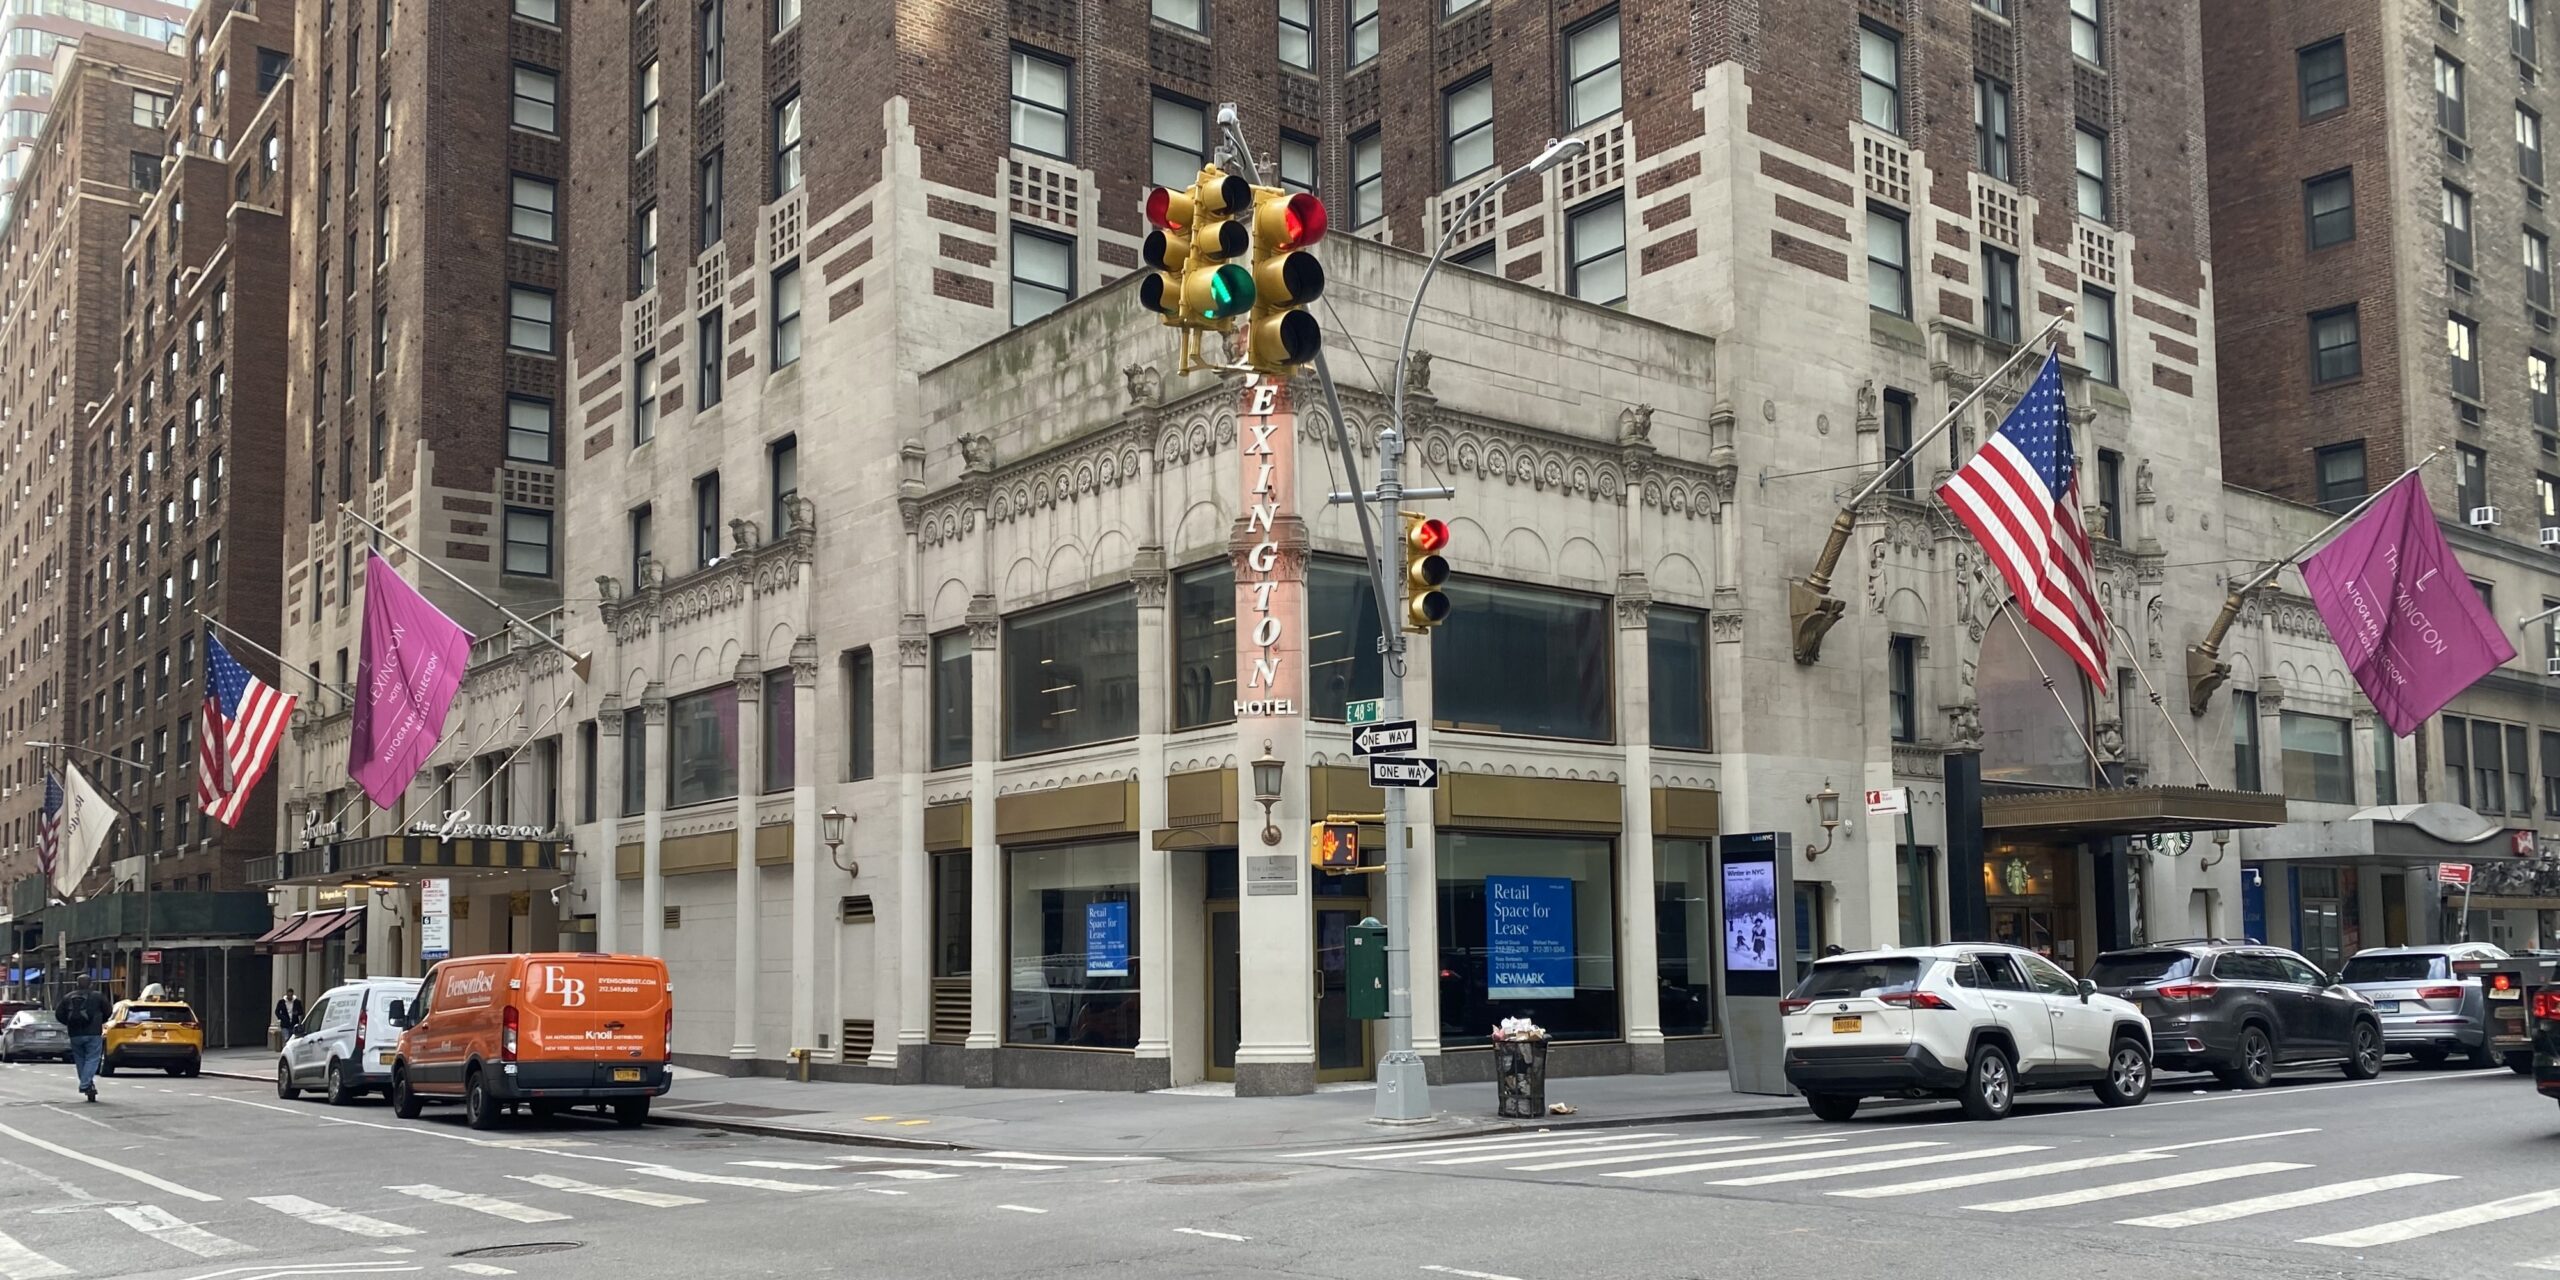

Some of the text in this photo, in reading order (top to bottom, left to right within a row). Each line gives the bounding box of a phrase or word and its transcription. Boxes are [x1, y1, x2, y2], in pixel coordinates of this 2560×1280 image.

[1244, 384, 1282, 689] EXINGTON
[2345, 580, 2381, 639] AUTOGRAPH
[2396, 582, 2448, 655] EXINGTON
[1233, 699, 1299, 716] HOTEL
[1347, 706, 1352, 722] E
[1354, 704, 1365, 721] 48
[1366, 702, 1374, 712] ST
[384, 711, 417, 763] AUTOGRAPH
[1362, 730, 1408, 746] ONE WAY
[1380, 765, 1428, 779] ONE WAY
[415, 809, 544, 844] the LEXINGTON
[1494, 883, 1529, 900] Retail
[1089, 907, 1107, 917] Retail
[1494, 901, 1551, 922] Space for
[1089, 918, 1117, 930] Space for
[1494, 919, 1529, 935] Lease
[1089, 929, 1106, 939] Lease
[1495, 972, 1545, 984] NEWMARK
[585, 1030, 612, 1040] Knoll
